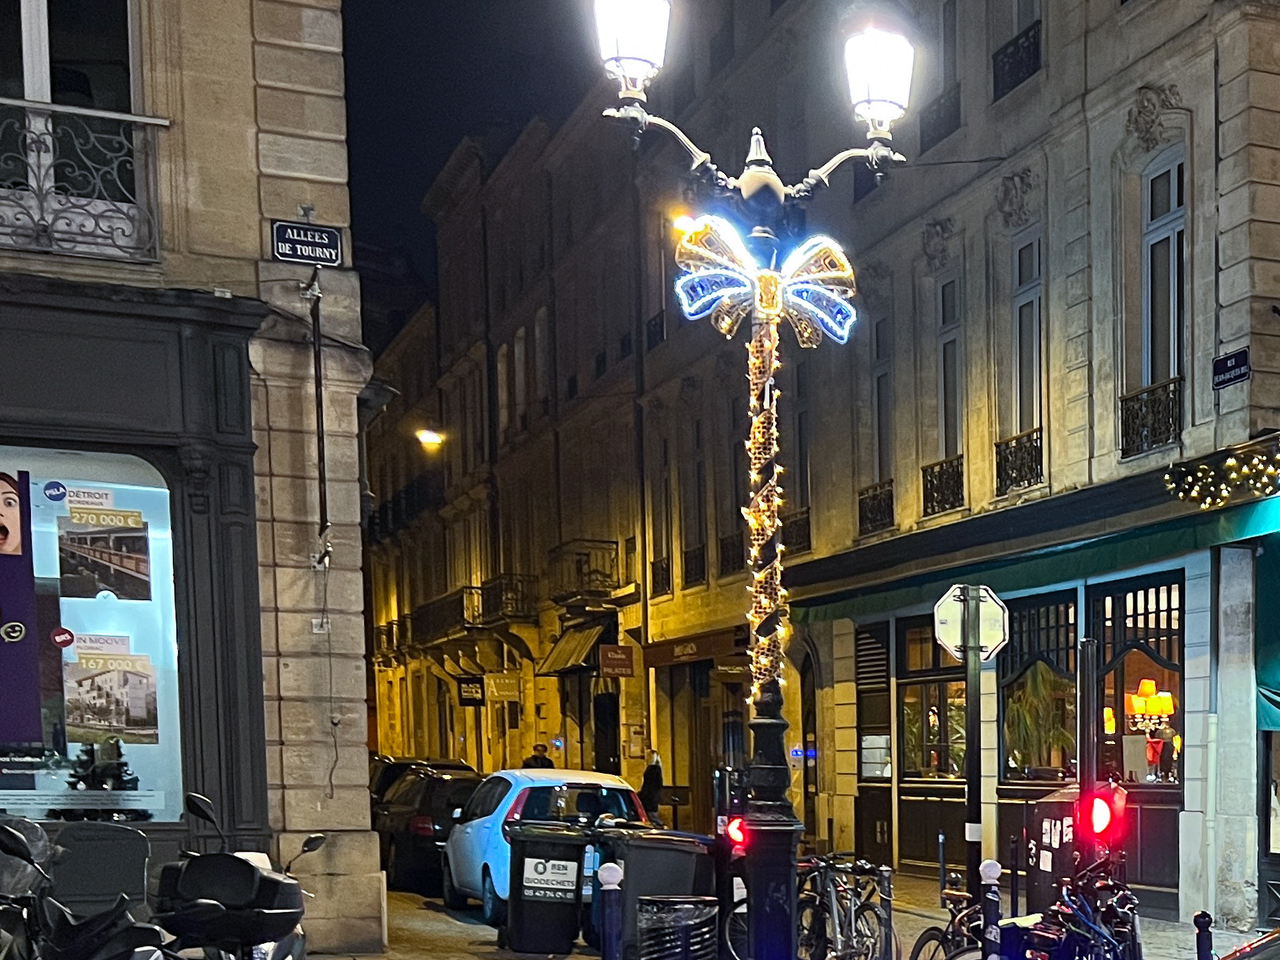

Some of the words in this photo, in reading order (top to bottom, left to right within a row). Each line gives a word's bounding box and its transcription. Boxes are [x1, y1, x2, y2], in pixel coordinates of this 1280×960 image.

[285, 228, 329, 244] ALLEES
[278, 242, 293, 255] DE
[295, 244, 338, 260] TOURNY
[72, 513, 96, 524] 270
[99, 514, 125, 526] 000
[76, 636, 87, 644] IN
[89, 637, 128, 645] MOOVE
[81, 659, 104, 669] 167
[107, 660, 132, 670] 000
[602, 667, 632, 676] PILATES
